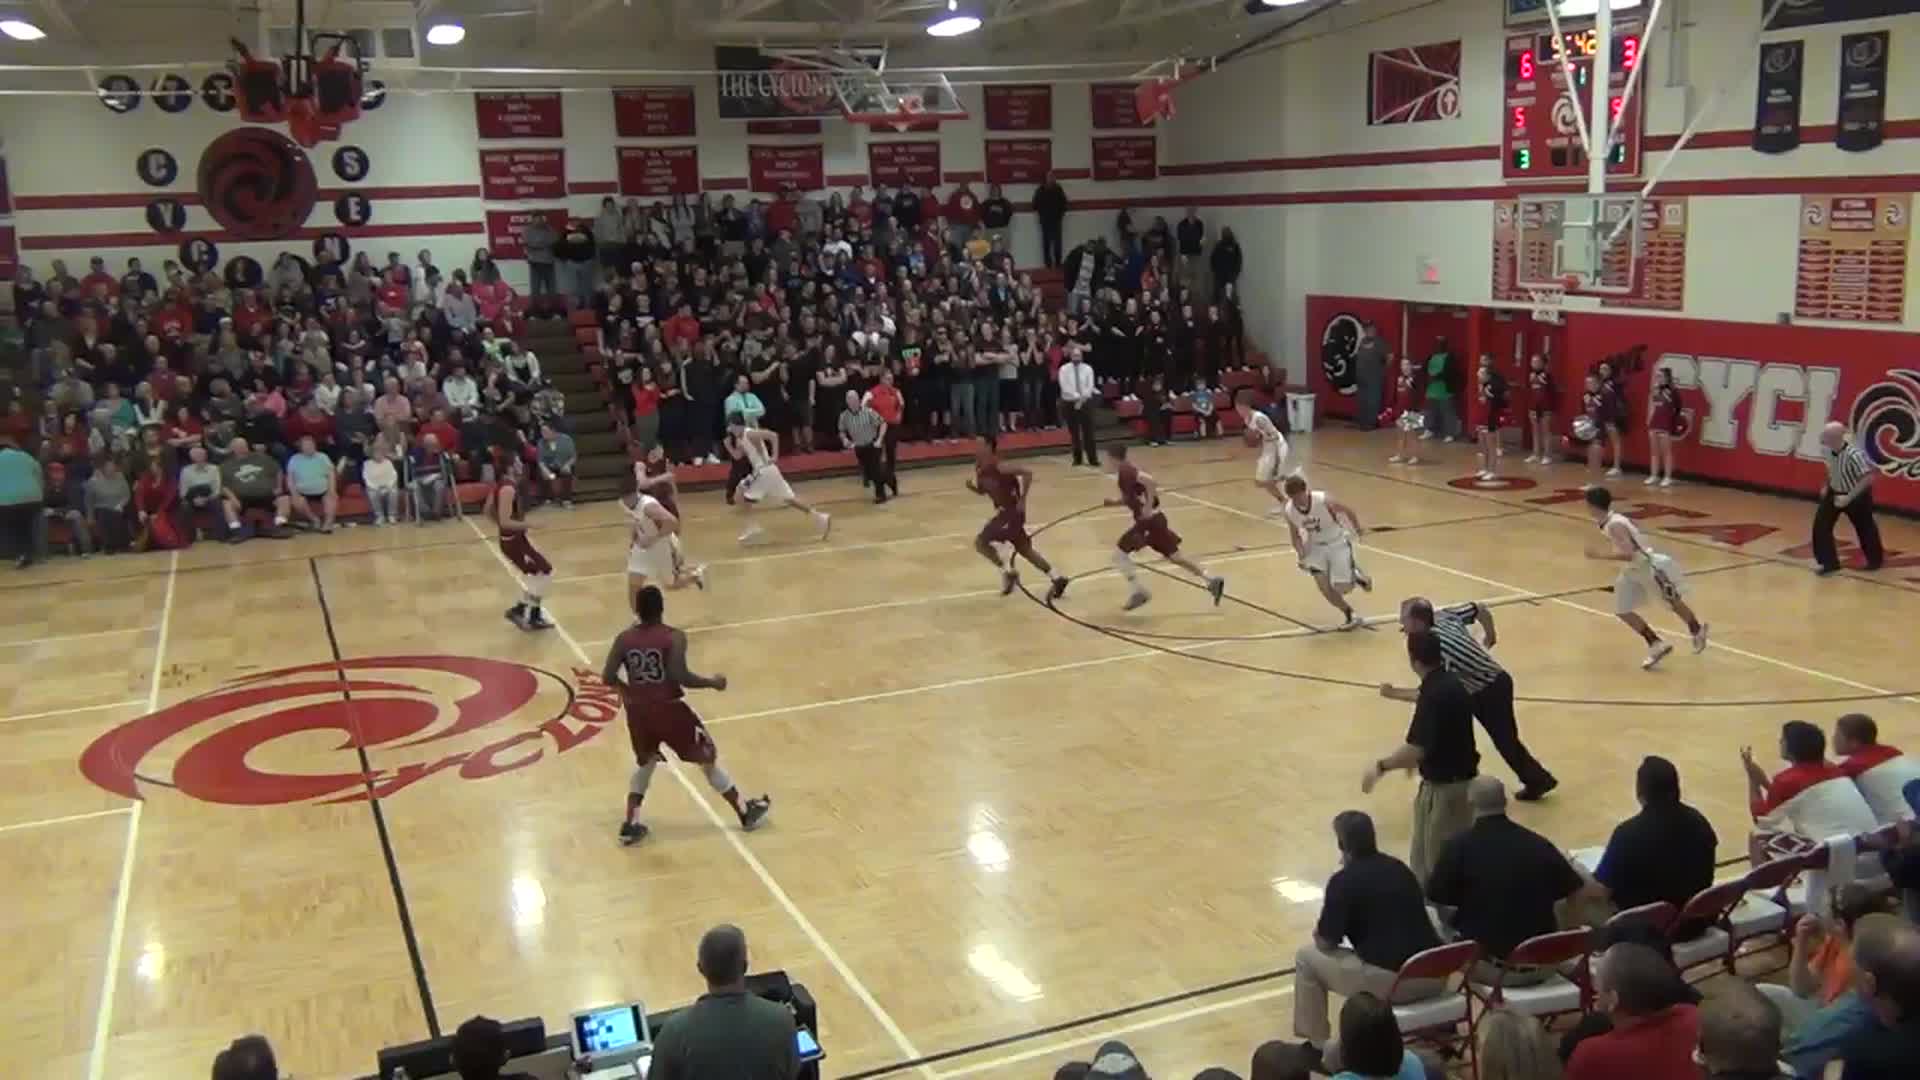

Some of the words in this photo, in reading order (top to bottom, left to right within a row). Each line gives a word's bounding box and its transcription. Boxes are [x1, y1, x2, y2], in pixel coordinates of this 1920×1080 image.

[1520, 52, 1533, 79] 6
[722, 72, 754, 97] THE
[1514, 106, 1525, 127] 5
[1519, 149, 1530, 169] 3
[628, 649, 665, 684] 23
